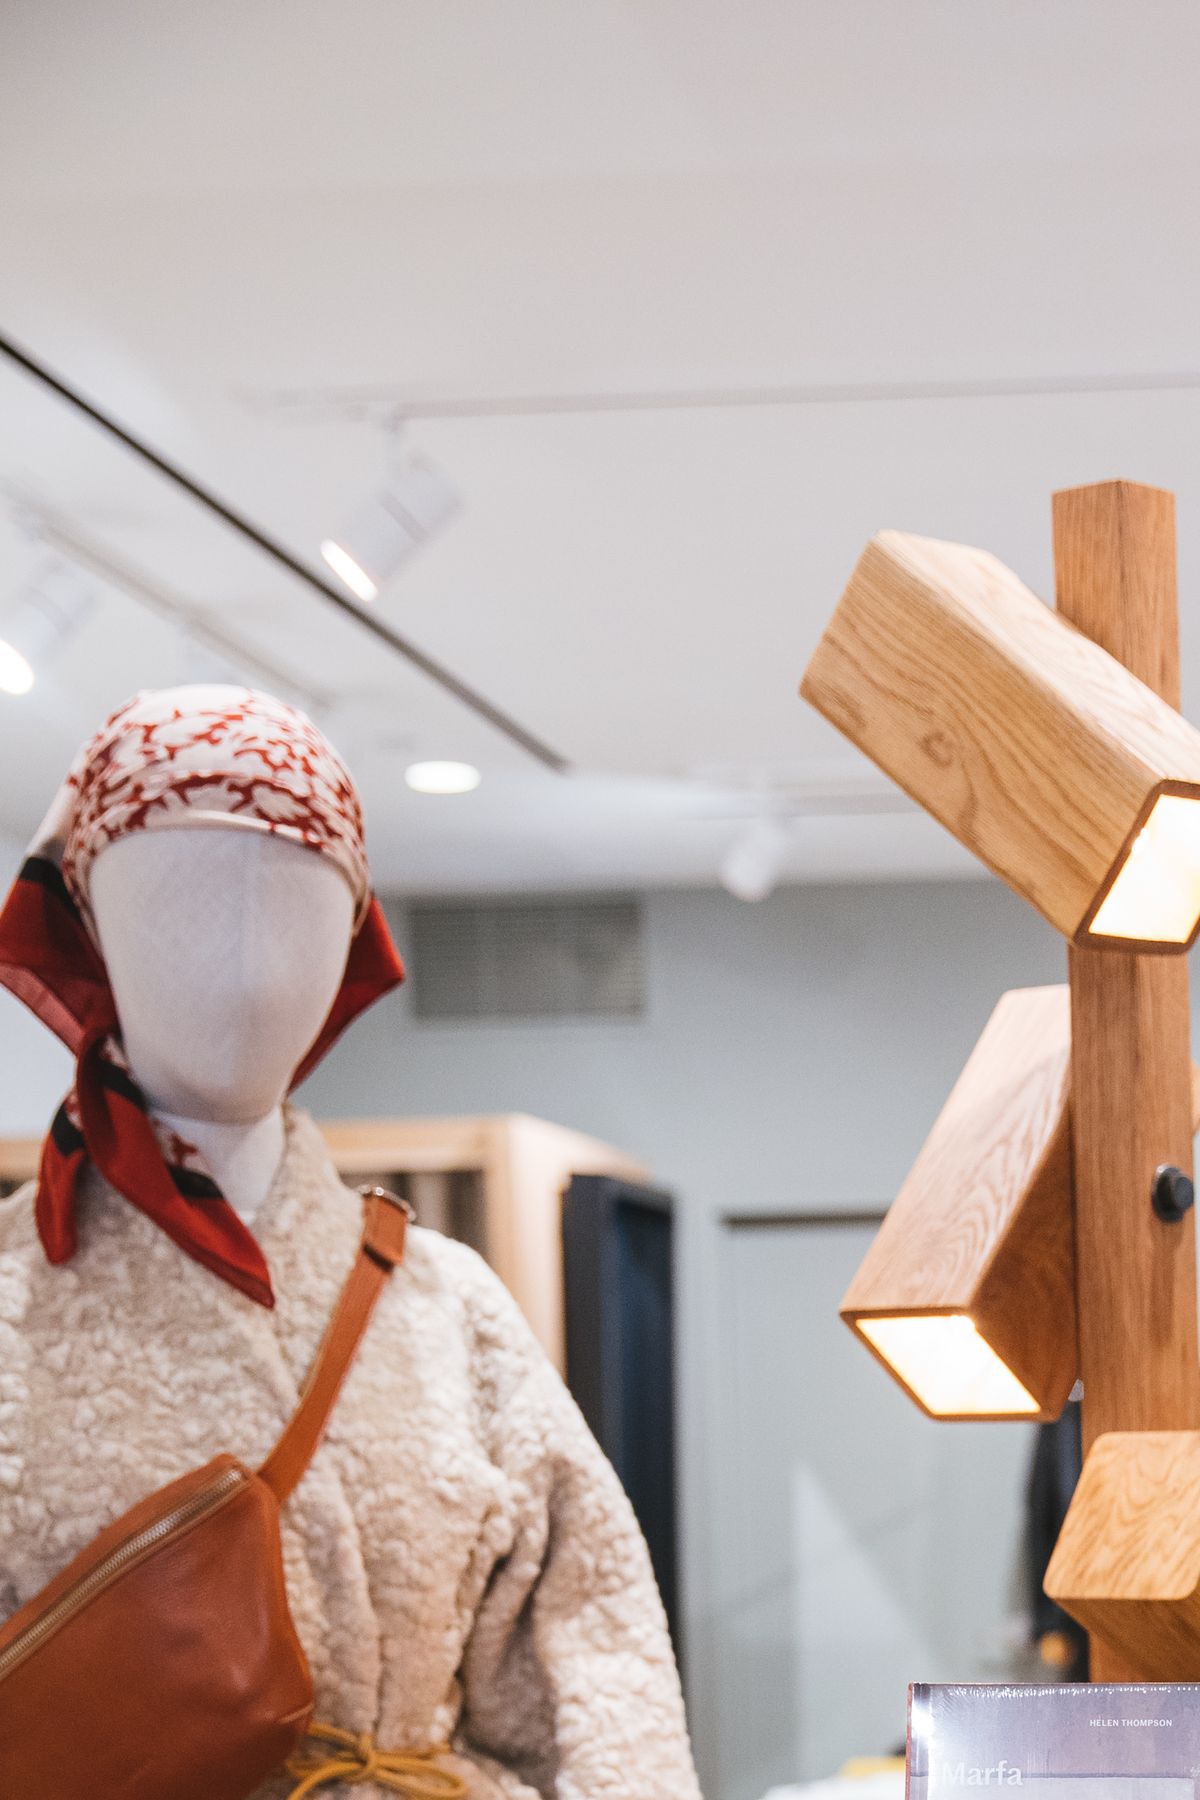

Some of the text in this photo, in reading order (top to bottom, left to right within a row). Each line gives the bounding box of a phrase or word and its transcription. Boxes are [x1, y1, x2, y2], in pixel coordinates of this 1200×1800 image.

[1089, 1718, 1173, 1728] HELEN THOMPSON
[941, 1759, 1024, 1787] Marfa
